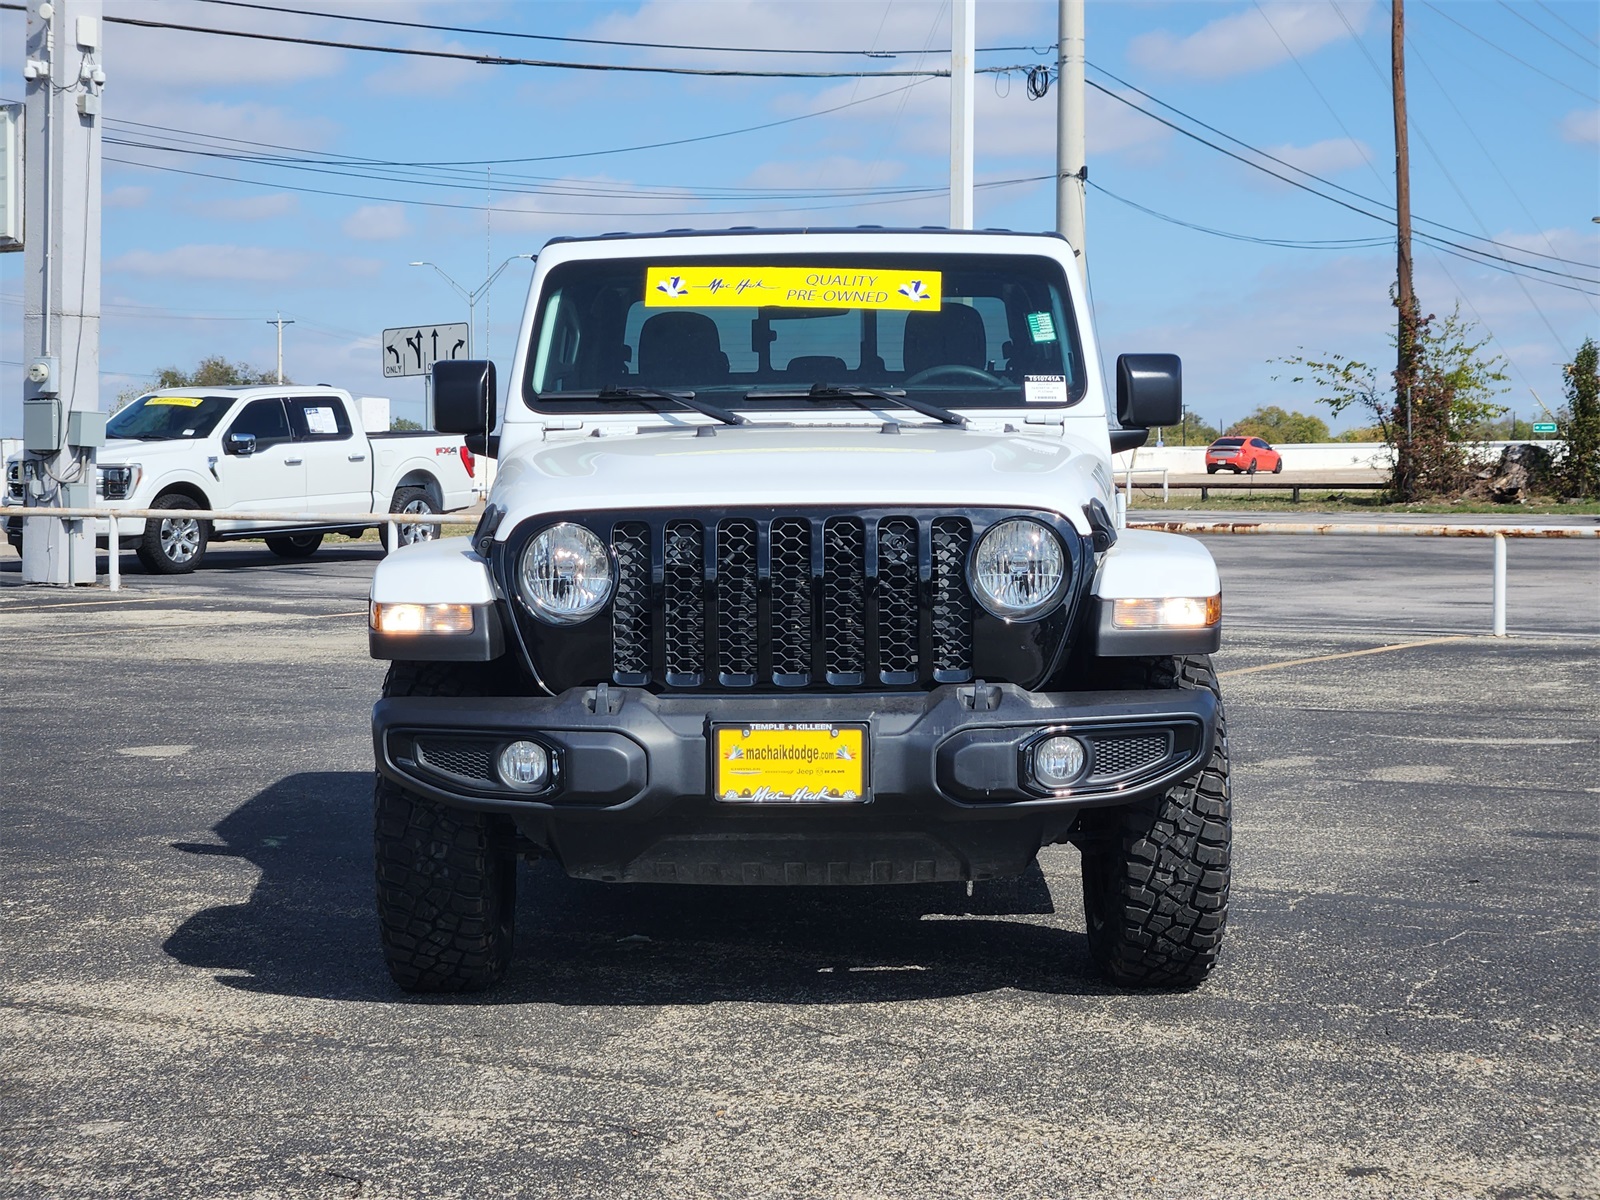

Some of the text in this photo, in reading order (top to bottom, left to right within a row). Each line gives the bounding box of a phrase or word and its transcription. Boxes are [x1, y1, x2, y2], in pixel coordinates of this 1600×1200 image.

[703, 278, 771, 295] Mac Haik
[805, 273, 879, 287] QUALITY
[786, 289, 889, 303] PRE-OWNED
[385, 365, 402, 374] ONLY
[435, 446, 457, 456] FX4
[796, 723, 833, 731] KILLEEN
[745, 744, 835, 763] machaikdodge.com
[796, 768, 814, 776] Jeep
[750, 785, 830, 802] Mac Haik
